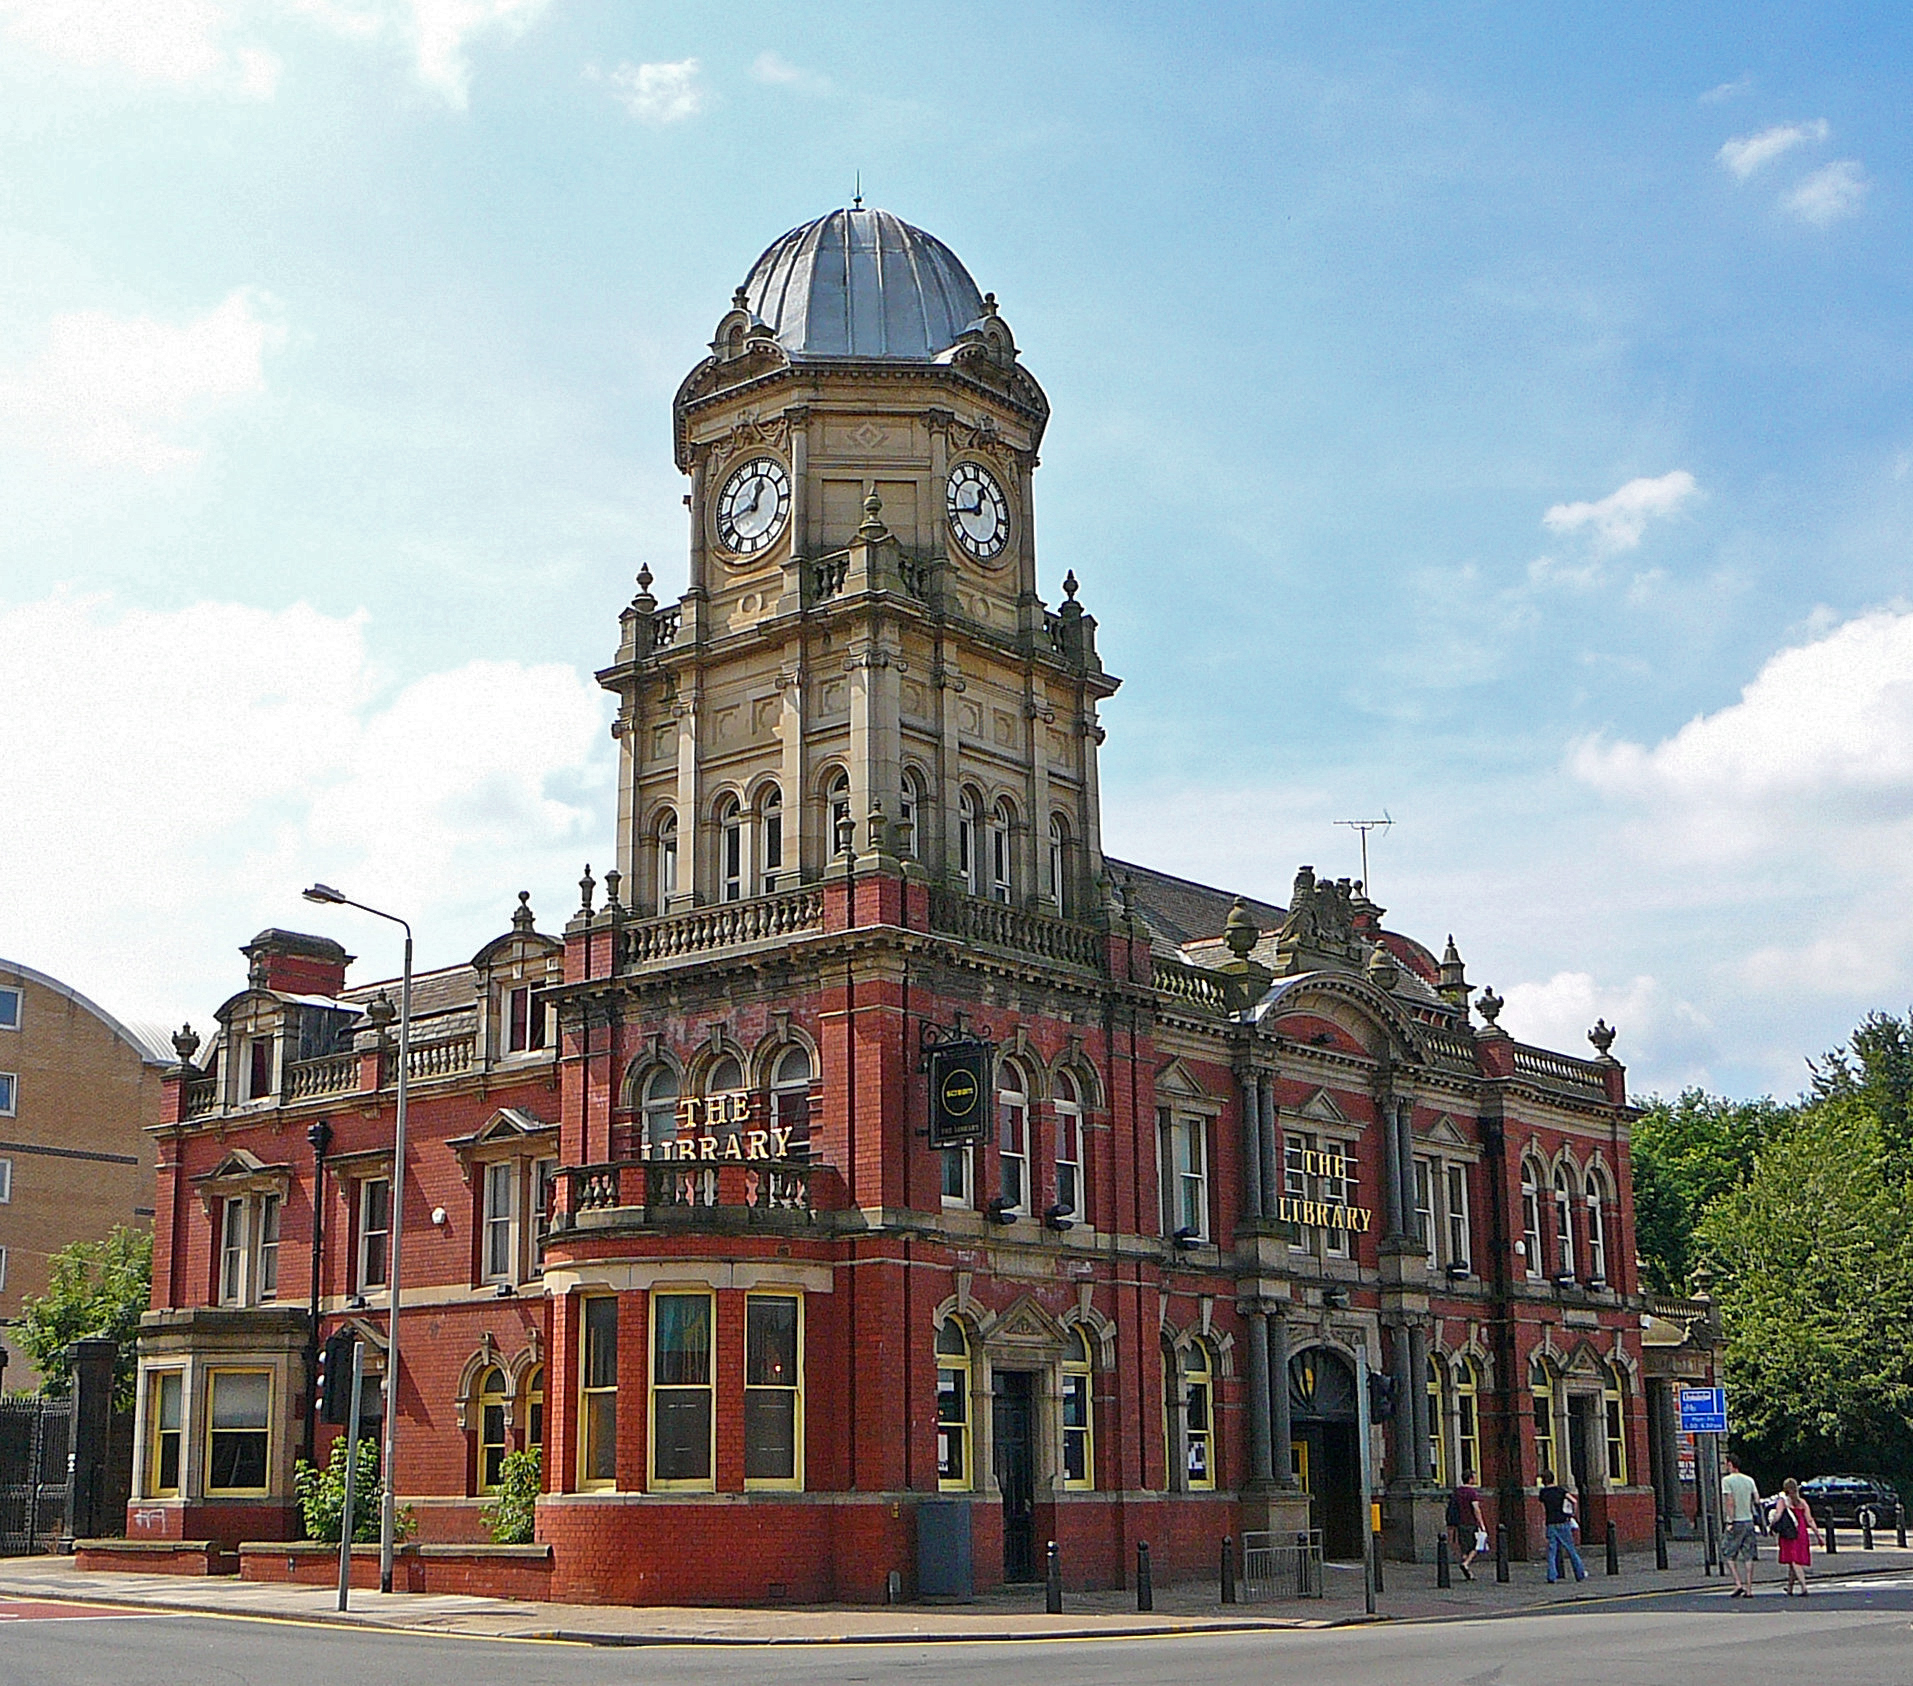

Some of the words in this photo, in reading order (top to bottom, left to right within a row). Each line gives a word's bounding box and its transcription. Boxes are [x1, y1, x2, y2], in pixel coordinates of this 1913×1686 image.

[680, 1092, 750, 1128] THE
[1302, 1149, 1345, 1179] THE
[1278, 1197, 1372, 1232] LIBRARY
